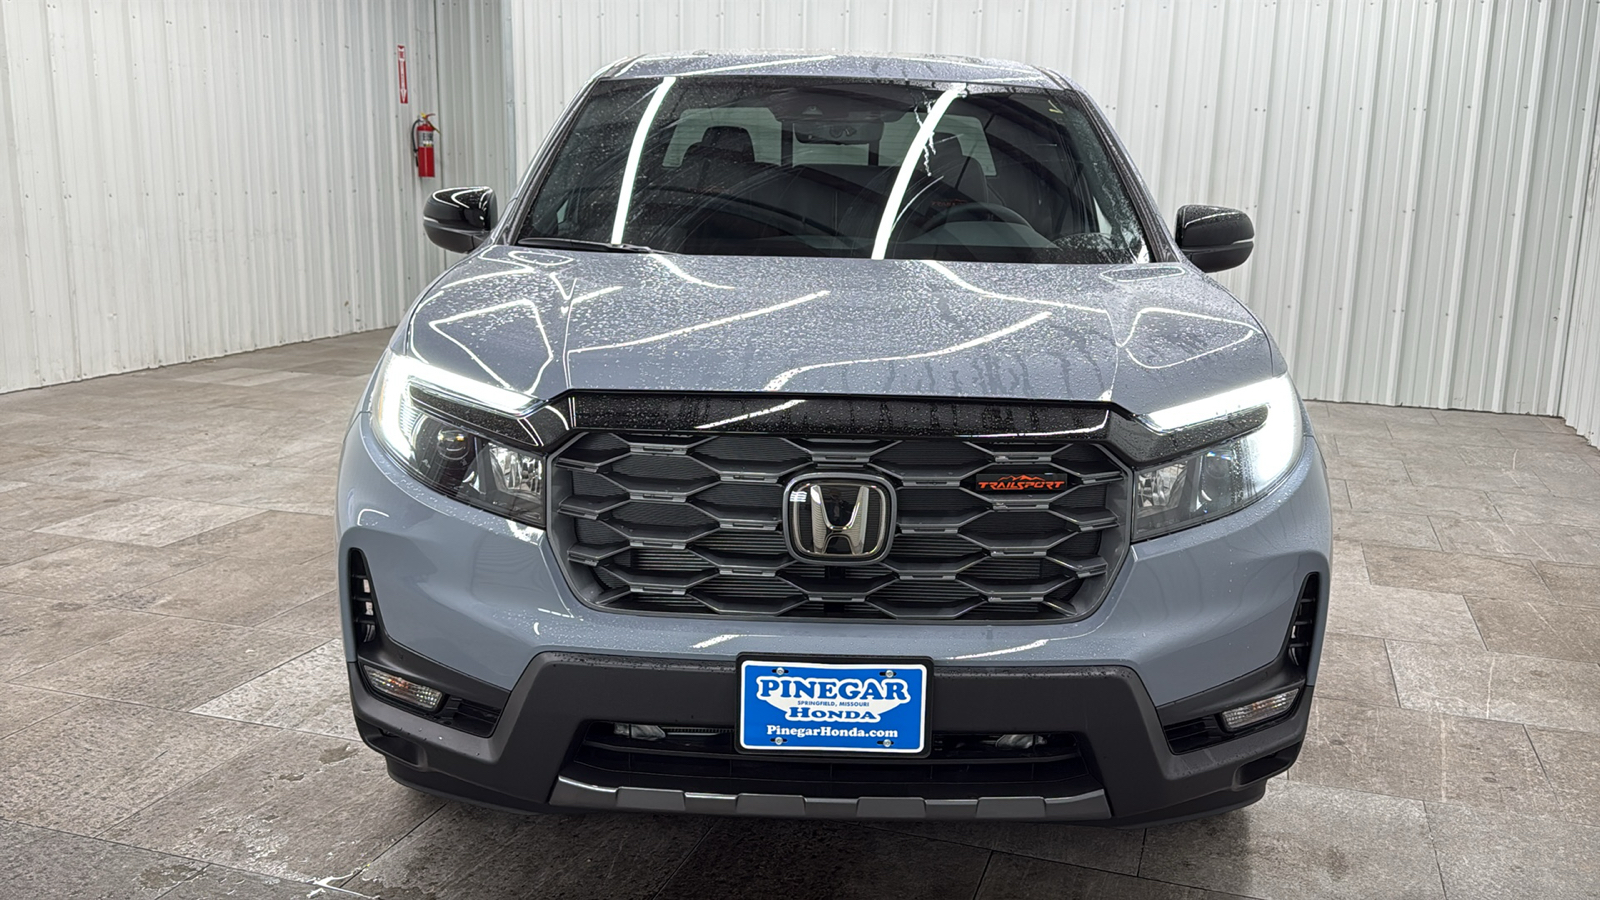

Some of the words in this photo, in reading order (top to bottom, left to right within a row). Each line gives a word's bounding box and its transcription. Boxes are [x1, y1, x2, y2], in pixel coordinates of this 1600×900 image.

[978, 481, 1065, 490] TRAILSPORT
[760, 679, 907, 700] PINEGAR
[788, 706, 877, 719] HONDA
[767, 725, 898, 738] PinegarHonda.com
